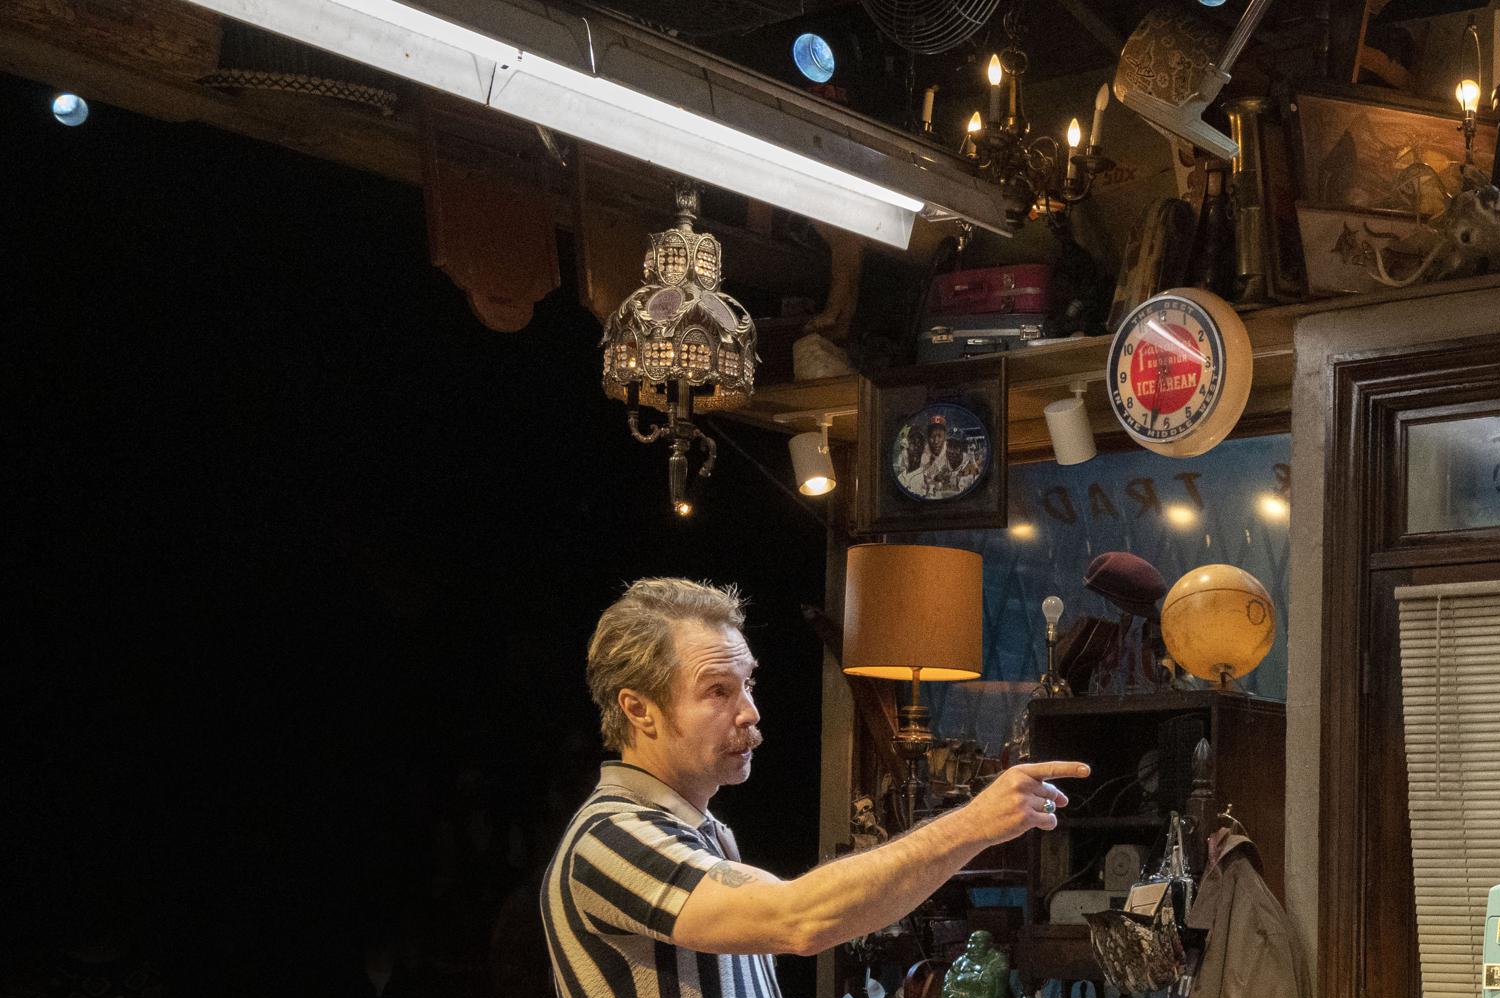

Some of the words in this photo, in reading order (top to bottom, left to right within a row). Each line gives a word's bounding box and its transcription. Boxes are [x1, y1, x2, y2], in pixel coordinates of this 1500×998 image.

[1198, 330, 1205, 342] 2
[1123, 343, 1134, 357] 10
[1119, 371, 1127, 384] 9
[1136, 379, 1156, 397] ICE
[1199, 383, 1207, 396] 4
[1126, 396, 1134, 409] 8
[1141, 413, 1149, 426] 7
[1184, 406, 1193, 420] 5
[1163, 417, 1171, 430] 6
